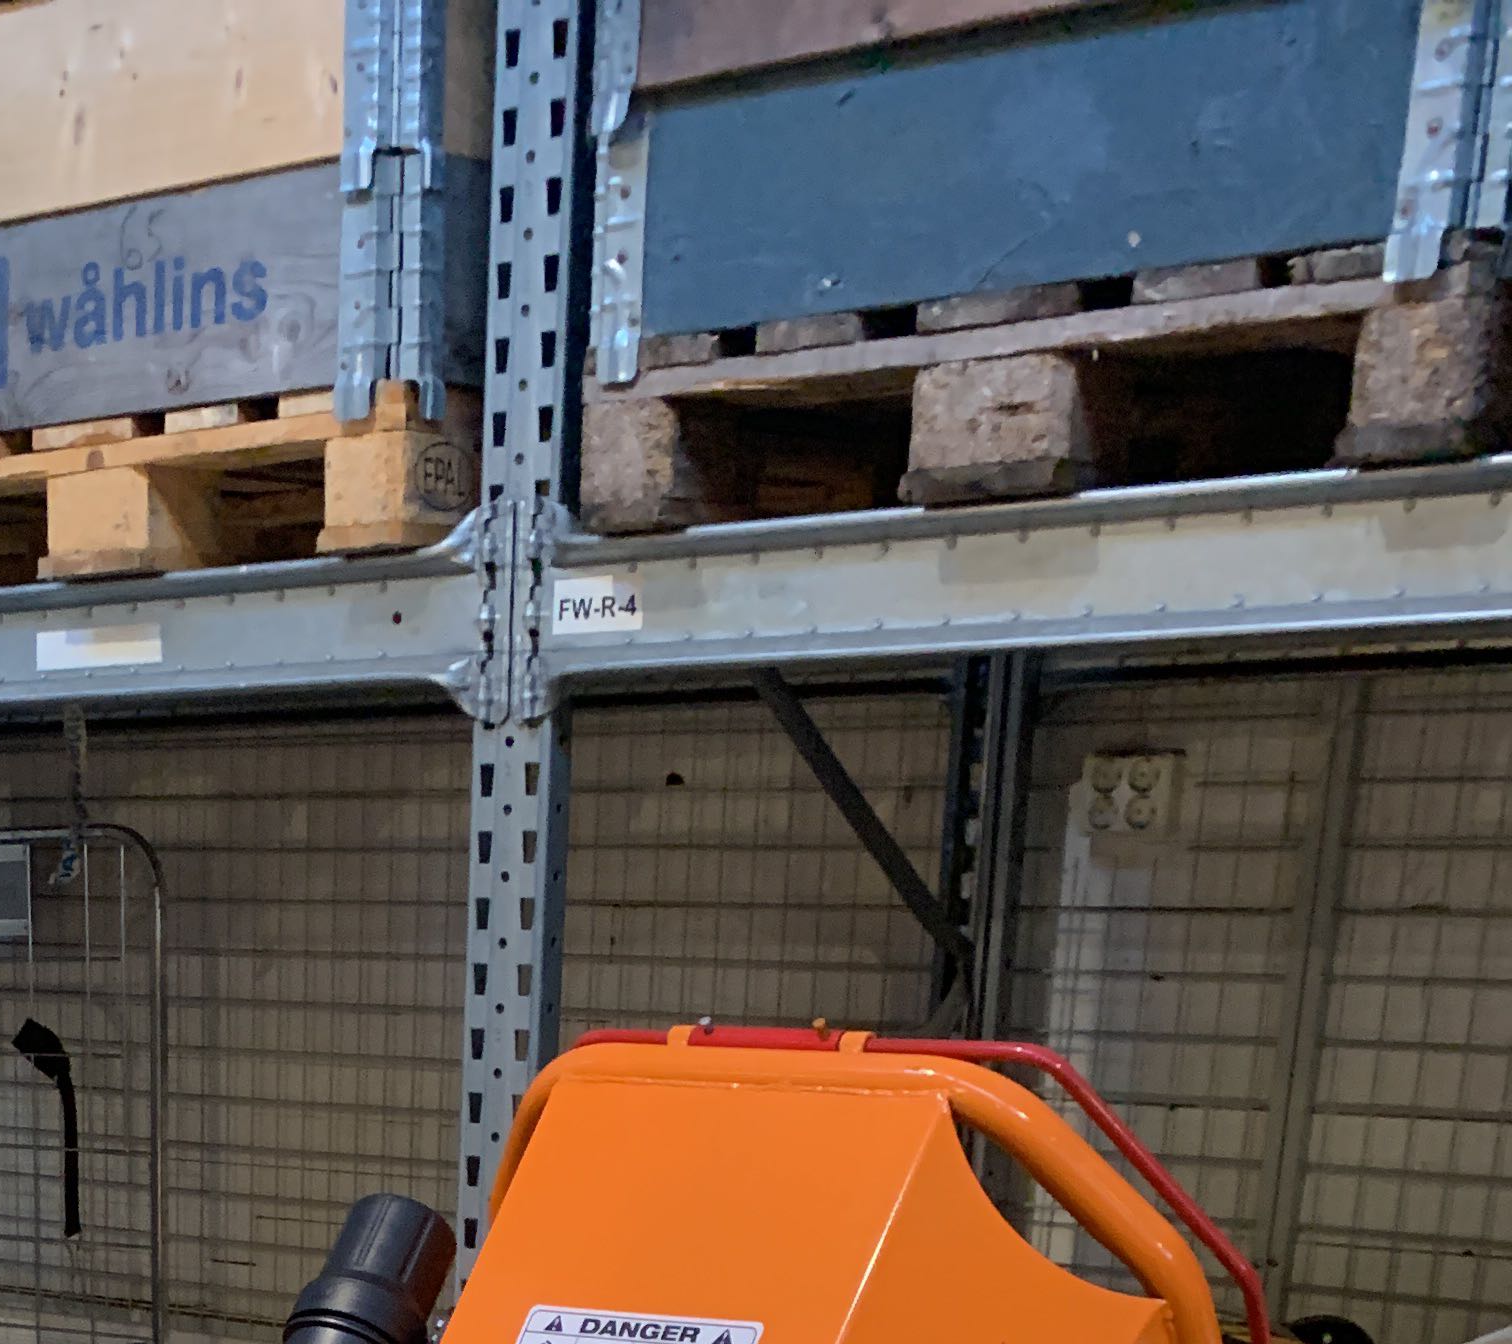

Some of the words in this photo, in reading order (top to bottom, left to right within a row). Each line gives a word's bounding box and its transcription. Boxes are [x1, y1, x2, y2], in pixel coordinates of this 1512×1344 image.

[24, 259, 268, 353] wåhlins
[423, 456, 466, 498] EPAL
[558, 594, 638, 622] FW-R-4
[578, 1318, 701, 1344] DANGER
